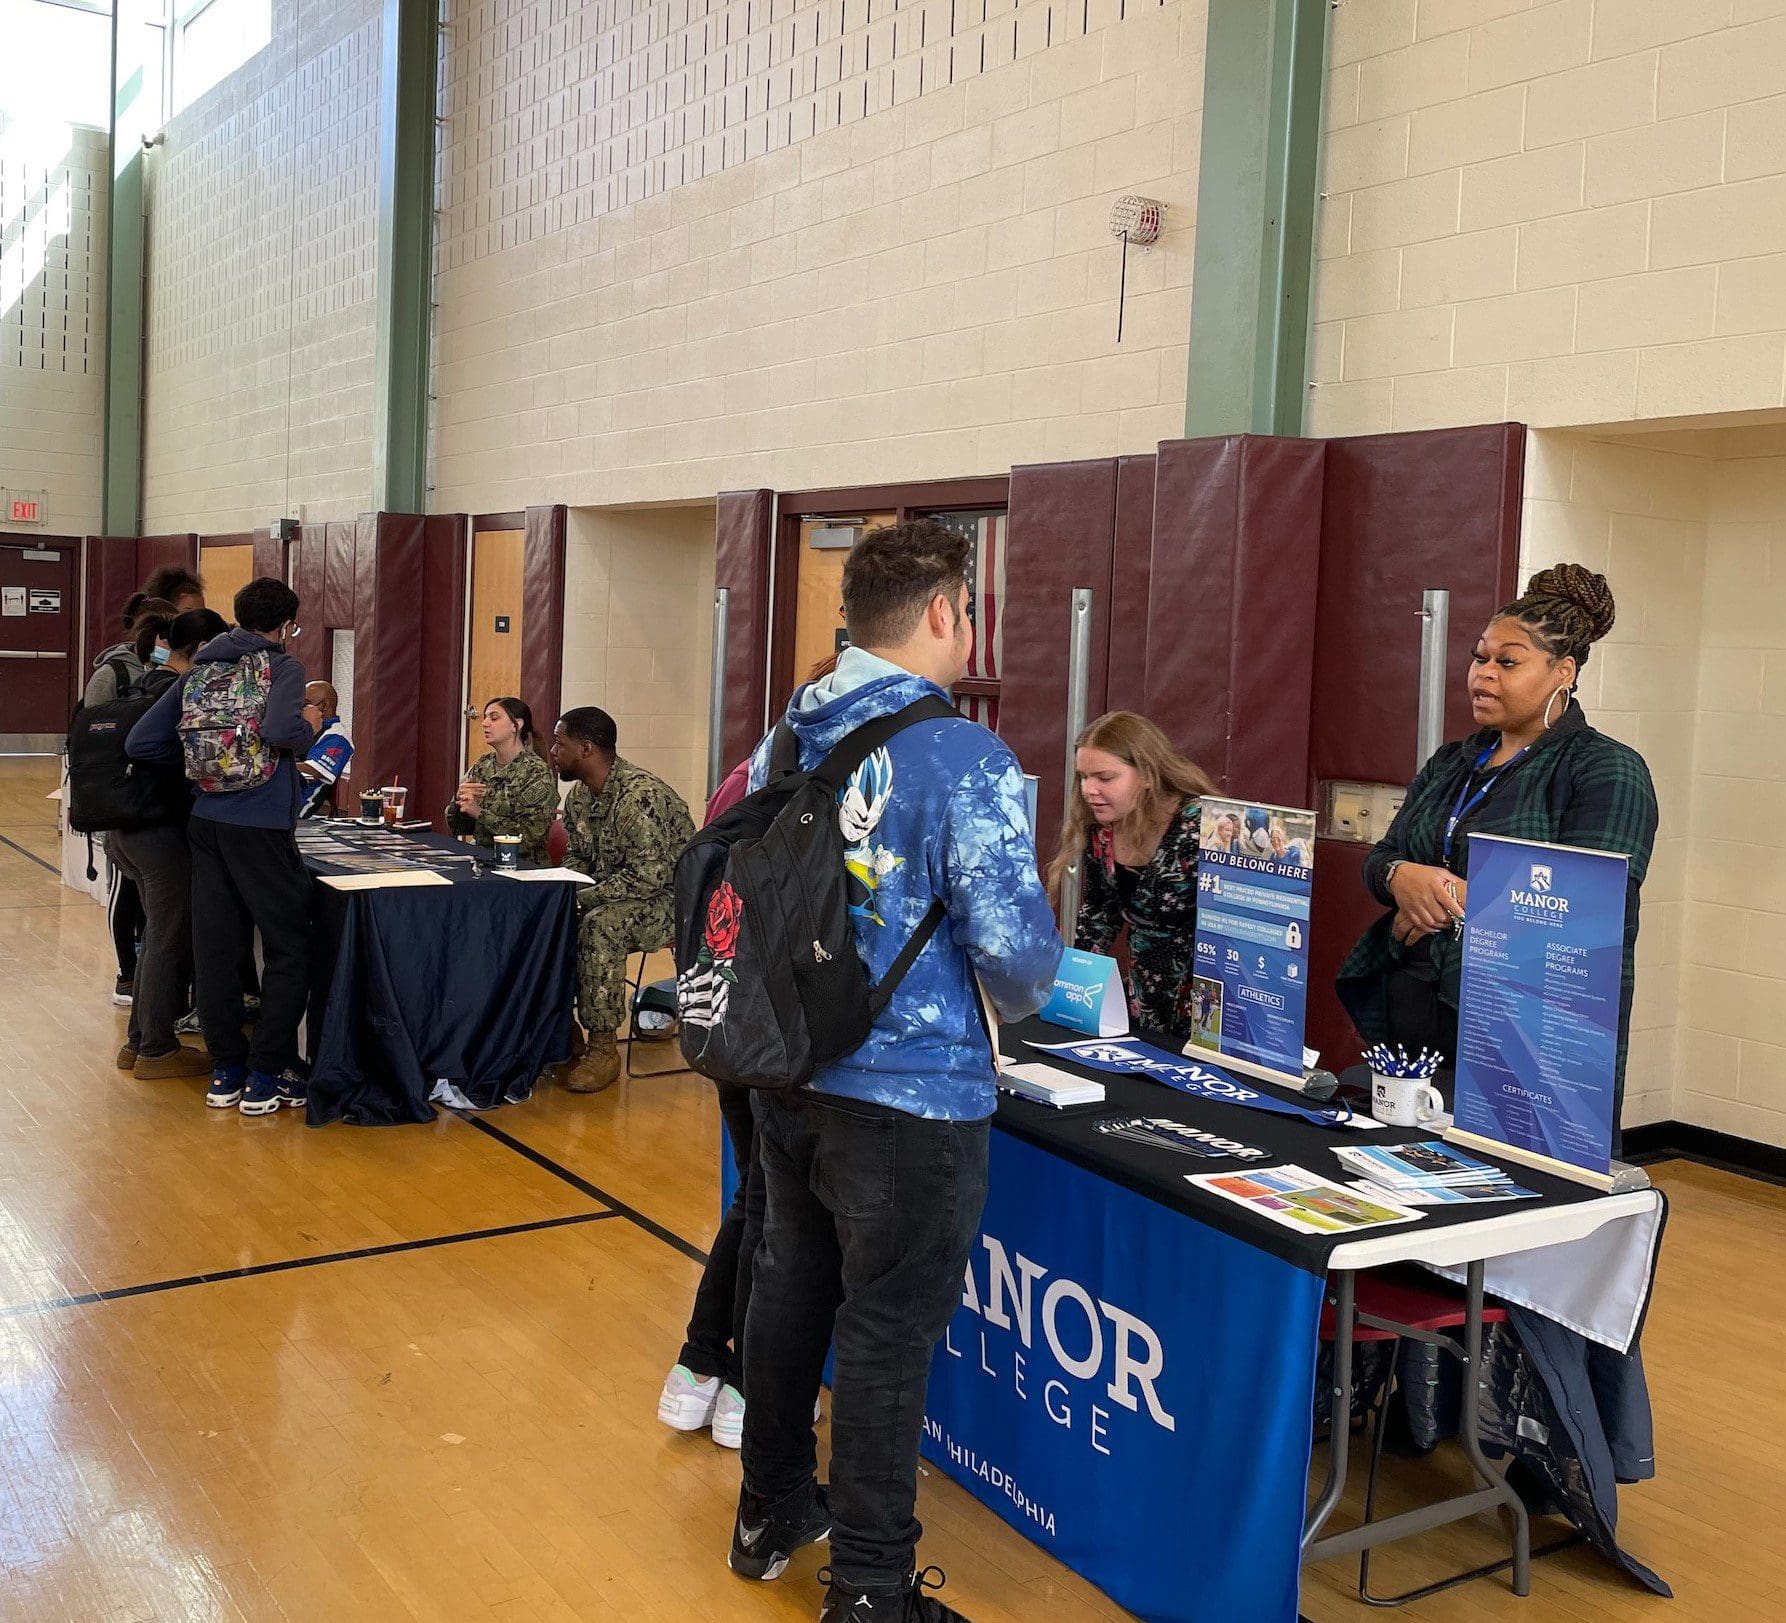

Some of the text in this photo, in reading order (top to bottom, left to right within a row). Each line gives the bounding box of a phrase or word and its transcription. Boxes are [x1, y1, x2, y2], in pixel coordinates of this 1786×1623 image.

[12, 500, 37, 519] EXIT
[1204, 850, 1309, 880] YOU BELONG HERE
[1199, 872, 1222, 895] #1
[1510, 889, 1569, 913] MANOR
[1513, 905, 1563, 920] COLLEGE
[1470, 927, 1508, 940] BACHELOR
[1197, 942, 1216, 956] 65%
[1470, 937, 1497, 948] DEGREE
[1546, 942, 1588, 957] ASSOCIATE
[1226, 949, 1239, 961] 30
[1469, 945, 1509, 960] PROGRAMS
[1545, 952, 1575, 964] DEGREE
[1545, 961, 1589, 977] PROGRAMS
[1053, 979, 1084, 993] ommon
[1065, 991, 1083, 1004] app
[1240, 988, 1281, 1006] ATHLETICS
[1502, 1084, 1553, 1105] CERTIFICATES
